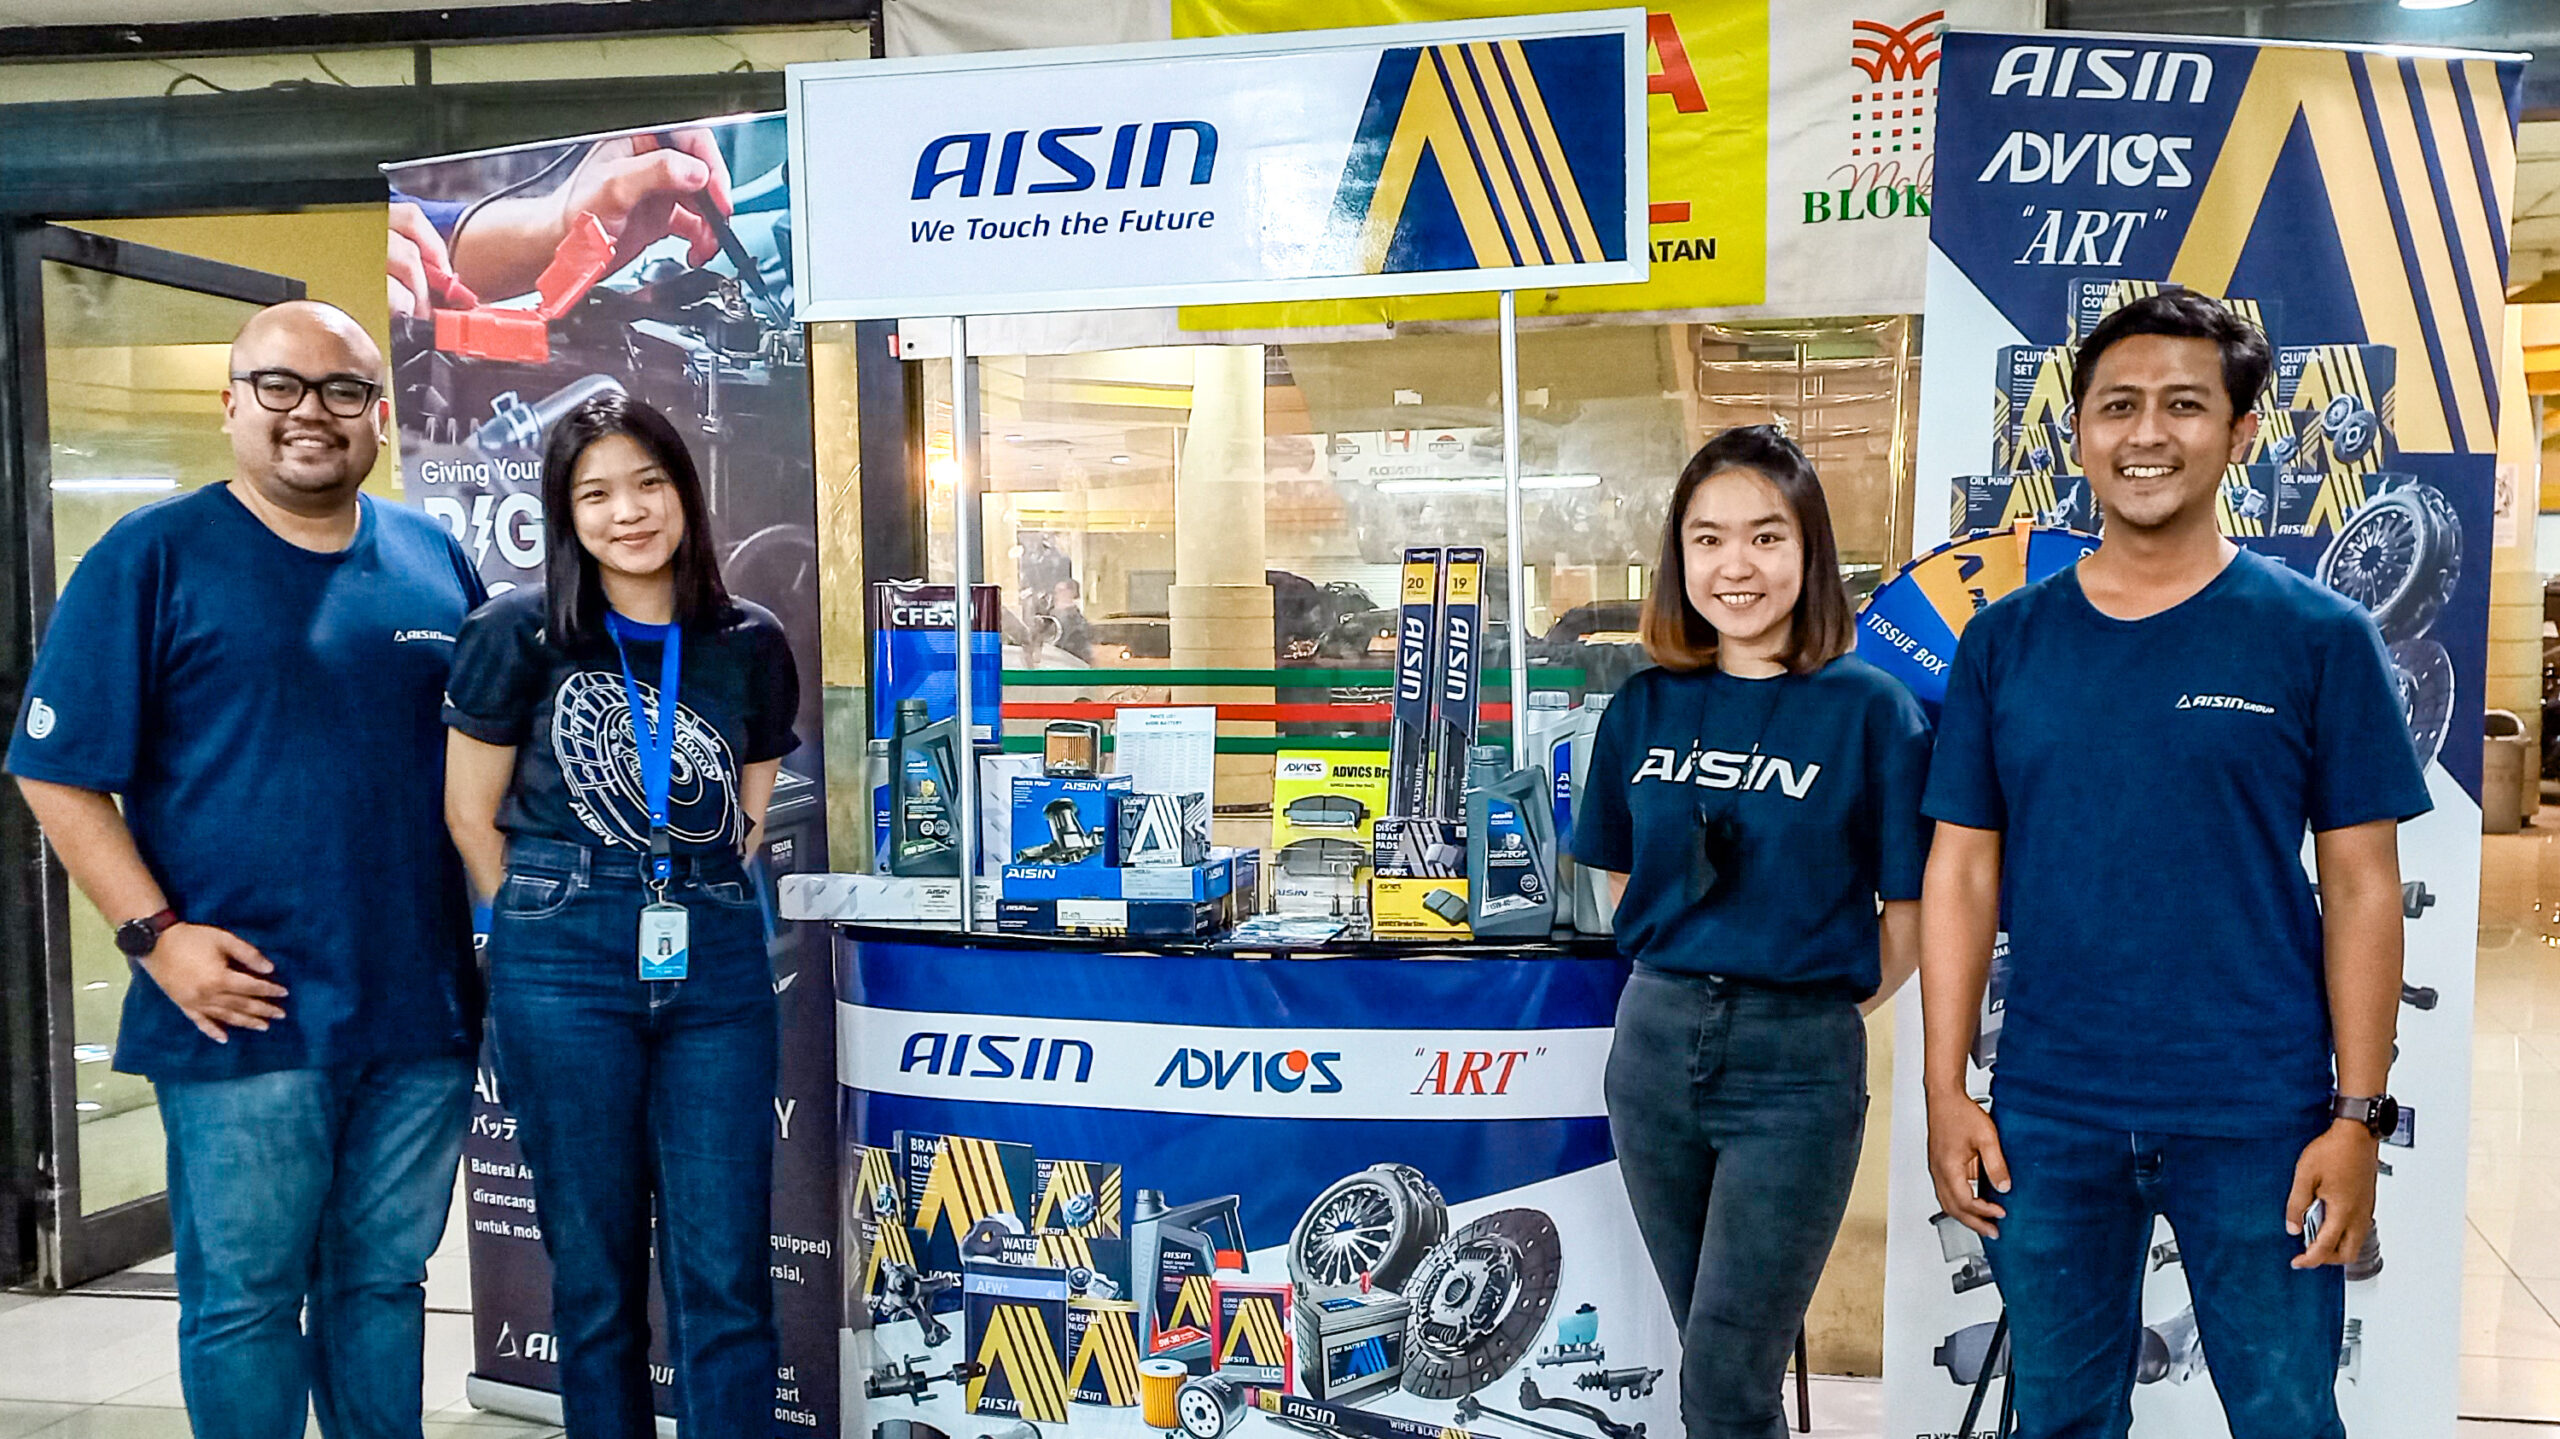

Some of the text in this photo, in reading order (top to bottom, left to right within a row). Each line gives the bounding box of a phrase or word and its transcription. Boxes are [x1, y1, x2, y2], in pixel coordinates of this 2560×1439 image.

[1989, 46, 2214, 103] AISIN
[911, 120, 1219, 200] AISIN
[1978, 132, 2193, 188] ADVICS
[1802, 184, 1931, 224] BLOK
[910, 207, 1214, 243] We Touch the Future
[2014, 350, 2060, 364] CLUTCH
[2280, 352, 2324, 364] CLUTCH
[2014, 364, 2033, 376] SET
[2280, 365, 2298, 376] SET
[421, 458, 541, 485] Giving Your
[1970, 476, 1986, 486] OIL
[2278, 524, 2314, 535] AISIN
[406, 629, 441, 640] AISIN
[1866, 613, 1949, 676] TISSUE BOX
[1401, 616, 1425, 701] AISIN
[1446, 616, 1470, 701] AISIN
[2193, 695, 2244, 709] AISIN
[1332, 766, 1372, 778] ADVICS
[1632, 738, 1821, 799] AISIN
[1061, 782, 1102, 791] AISIN
[568, 801, 619, 846] AISIN
[1375, 824, 1397, 832] DISC
[1375, 833, 1404, 841] BRAKE
[1375, 841, 1399, 850] PADS
[1005, 868, 1057, 879] AISIN
[900, 1032, 1094, 1083] AISIN
[1153, 1048, 1343, 1095] ADVICS
[910, 1138, 948, 1153] BRAKE
[471, 1158, 515, 1178] Baterai
[910, 1154, 937, 1168] DISC
[473, 1188, 536, 1213] dirancang
[475, 1219, 511, 1237] untuk
[1002, 1237, 1038, 1250] WATER
[1163, 1251, 1192, 1260] AISIN
[1223, 1356, 1249, 1364] AISIN
[1069, 1388, 1102, 1401] AISIN
[977, 1396, 1024, 1412] AISIN
[1287, 1402, 1336, 1425] AISIN
[1390, 1420, 1415, 1433] WIPER
